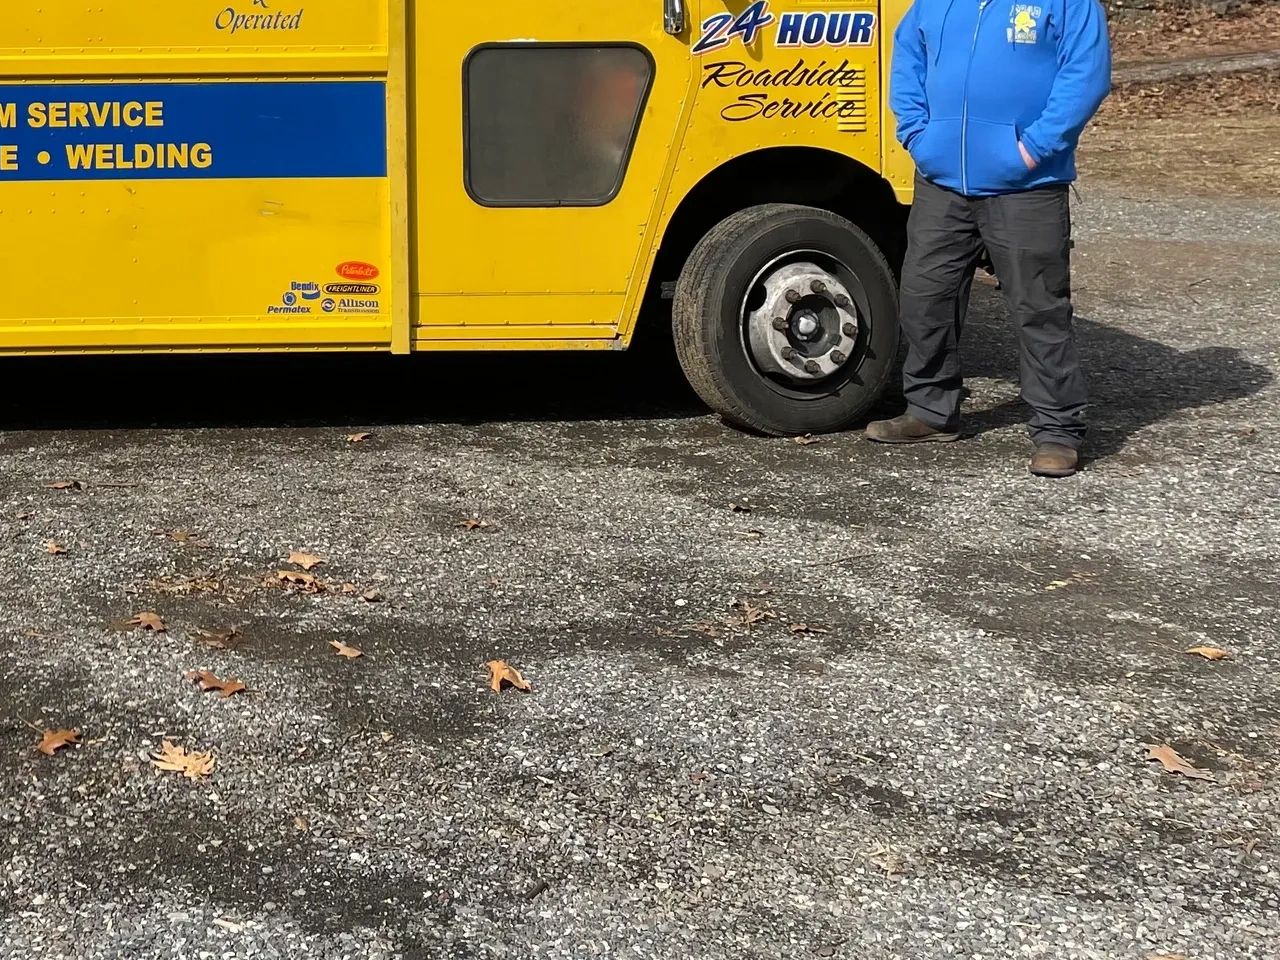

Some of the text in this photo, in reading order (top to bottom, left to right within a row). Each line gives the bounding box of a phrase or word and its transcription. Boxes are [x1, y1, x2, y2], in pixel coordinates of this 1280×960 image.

[215, 8, 303, 34] Operated
[690, 0, 876, 55] 24 HOUR
[702, 58, 859, 89] Roadside
[27, 100, 165, 127] SERVICE
[720, 92, 858, 122] Service
[65, 142, 213, 170] WELDING
[291, 281, 319, 290] Bendix
[328, 285, 376, 293] FREIGHTLINER
[267, 305, 311, 313] Permatex
[338, 298, 379, 308] Allison
